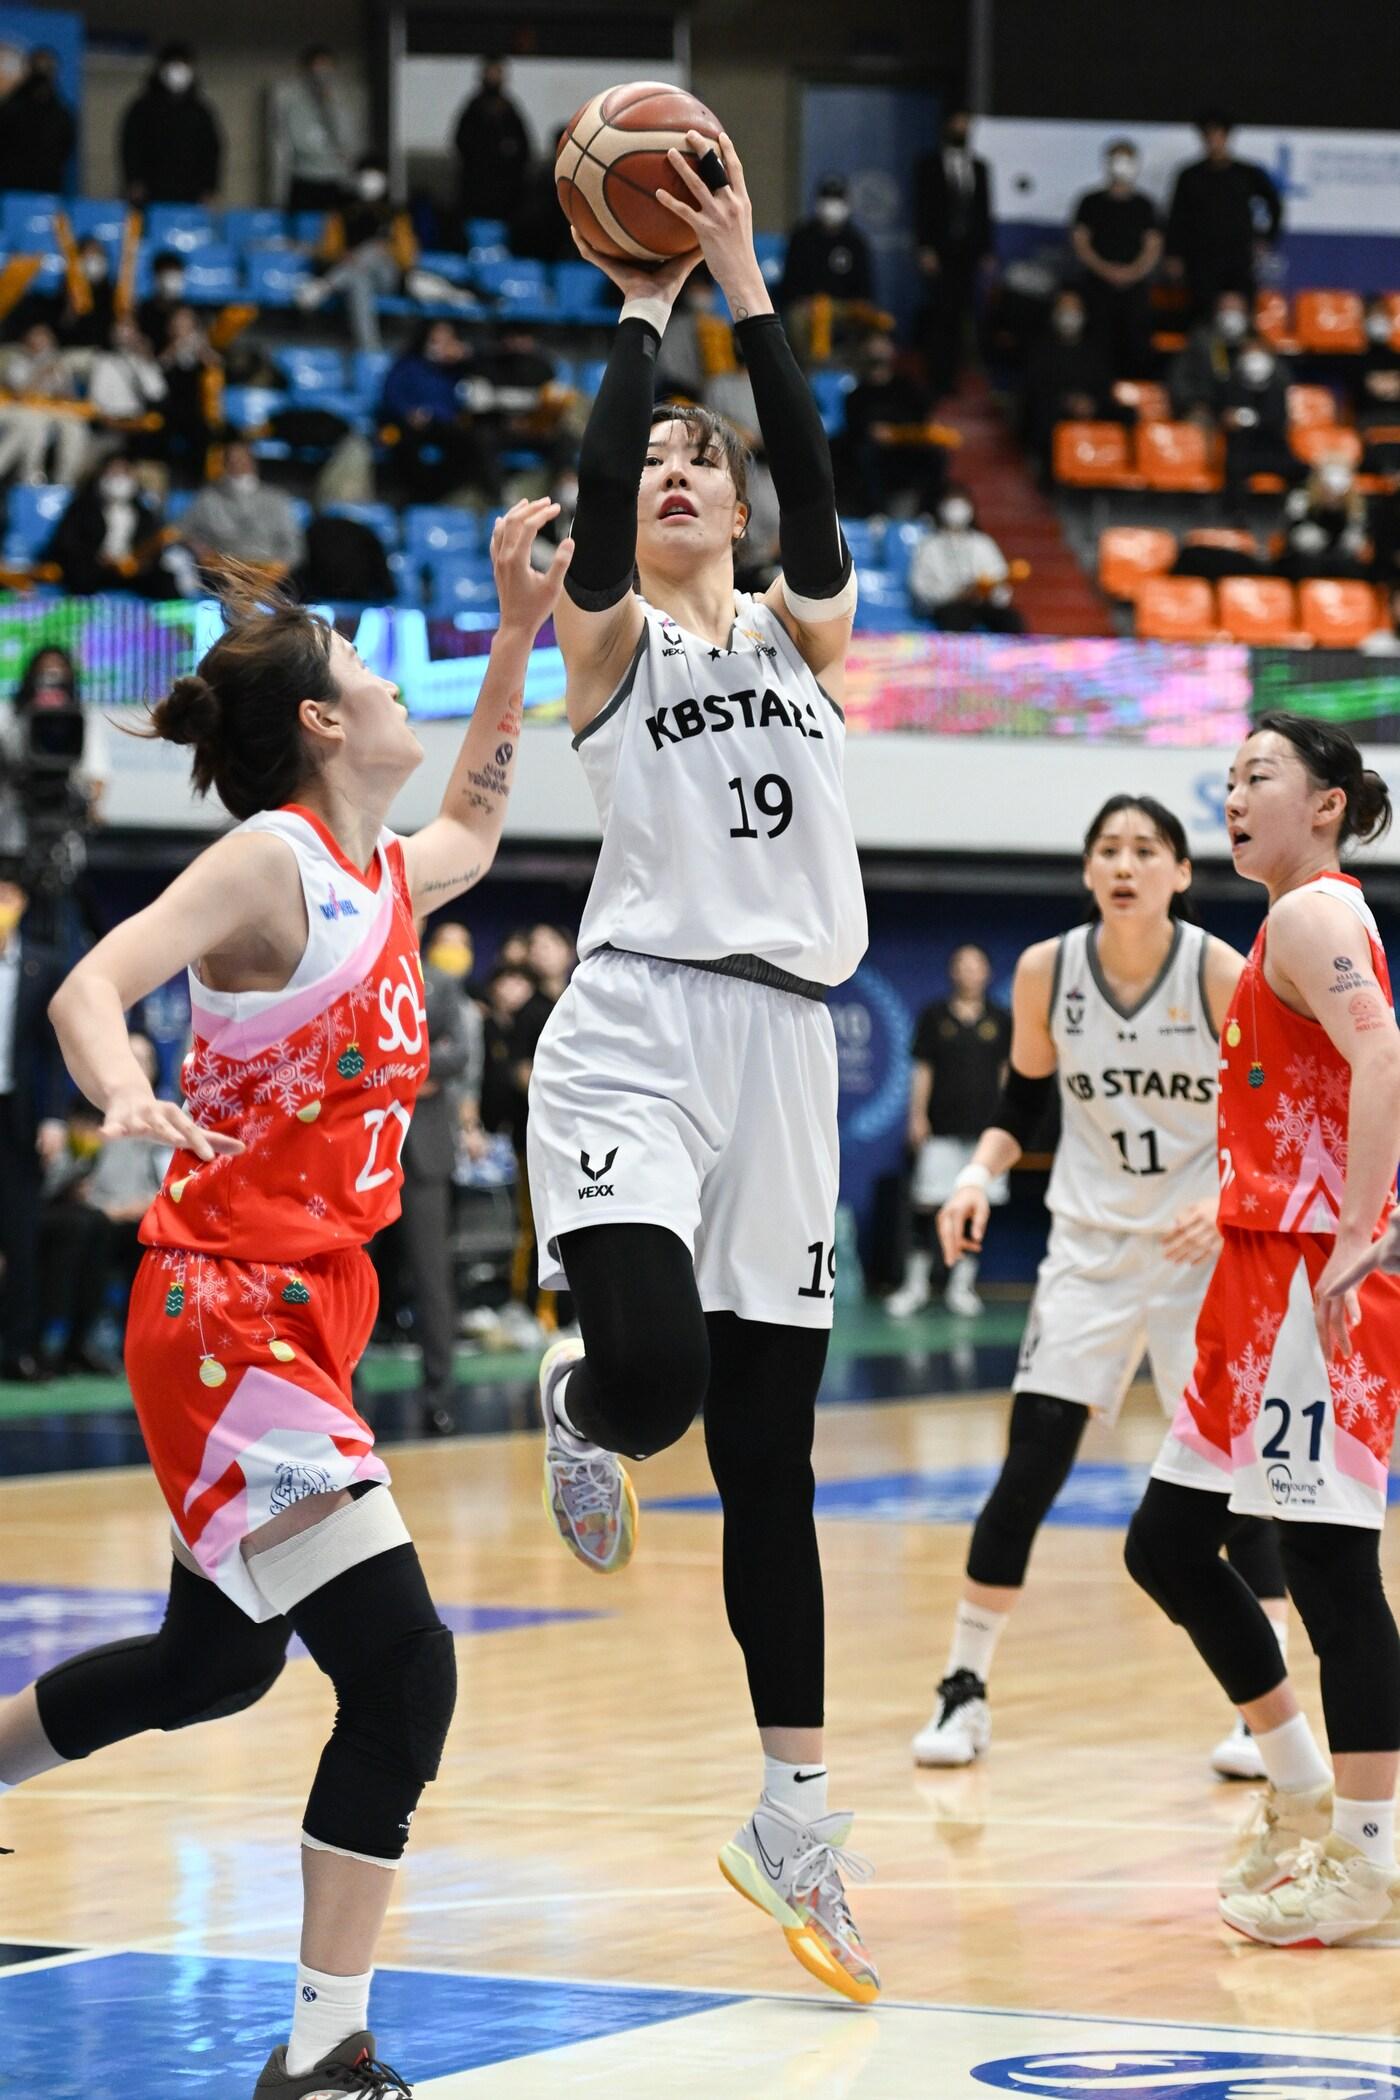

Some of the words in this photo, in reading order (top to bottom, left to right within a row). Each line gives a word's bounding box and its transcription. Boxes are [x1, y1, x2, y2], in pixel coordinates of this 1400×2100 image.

[728, 773, 793, 839] 19
[1102, 1068, 1217, 1104] STARS
[1111, 1128, 1168, 1176] 11
[578, 1184, 615, 1200] VEXX
[1262, 1398, 1326, 1462] 21
